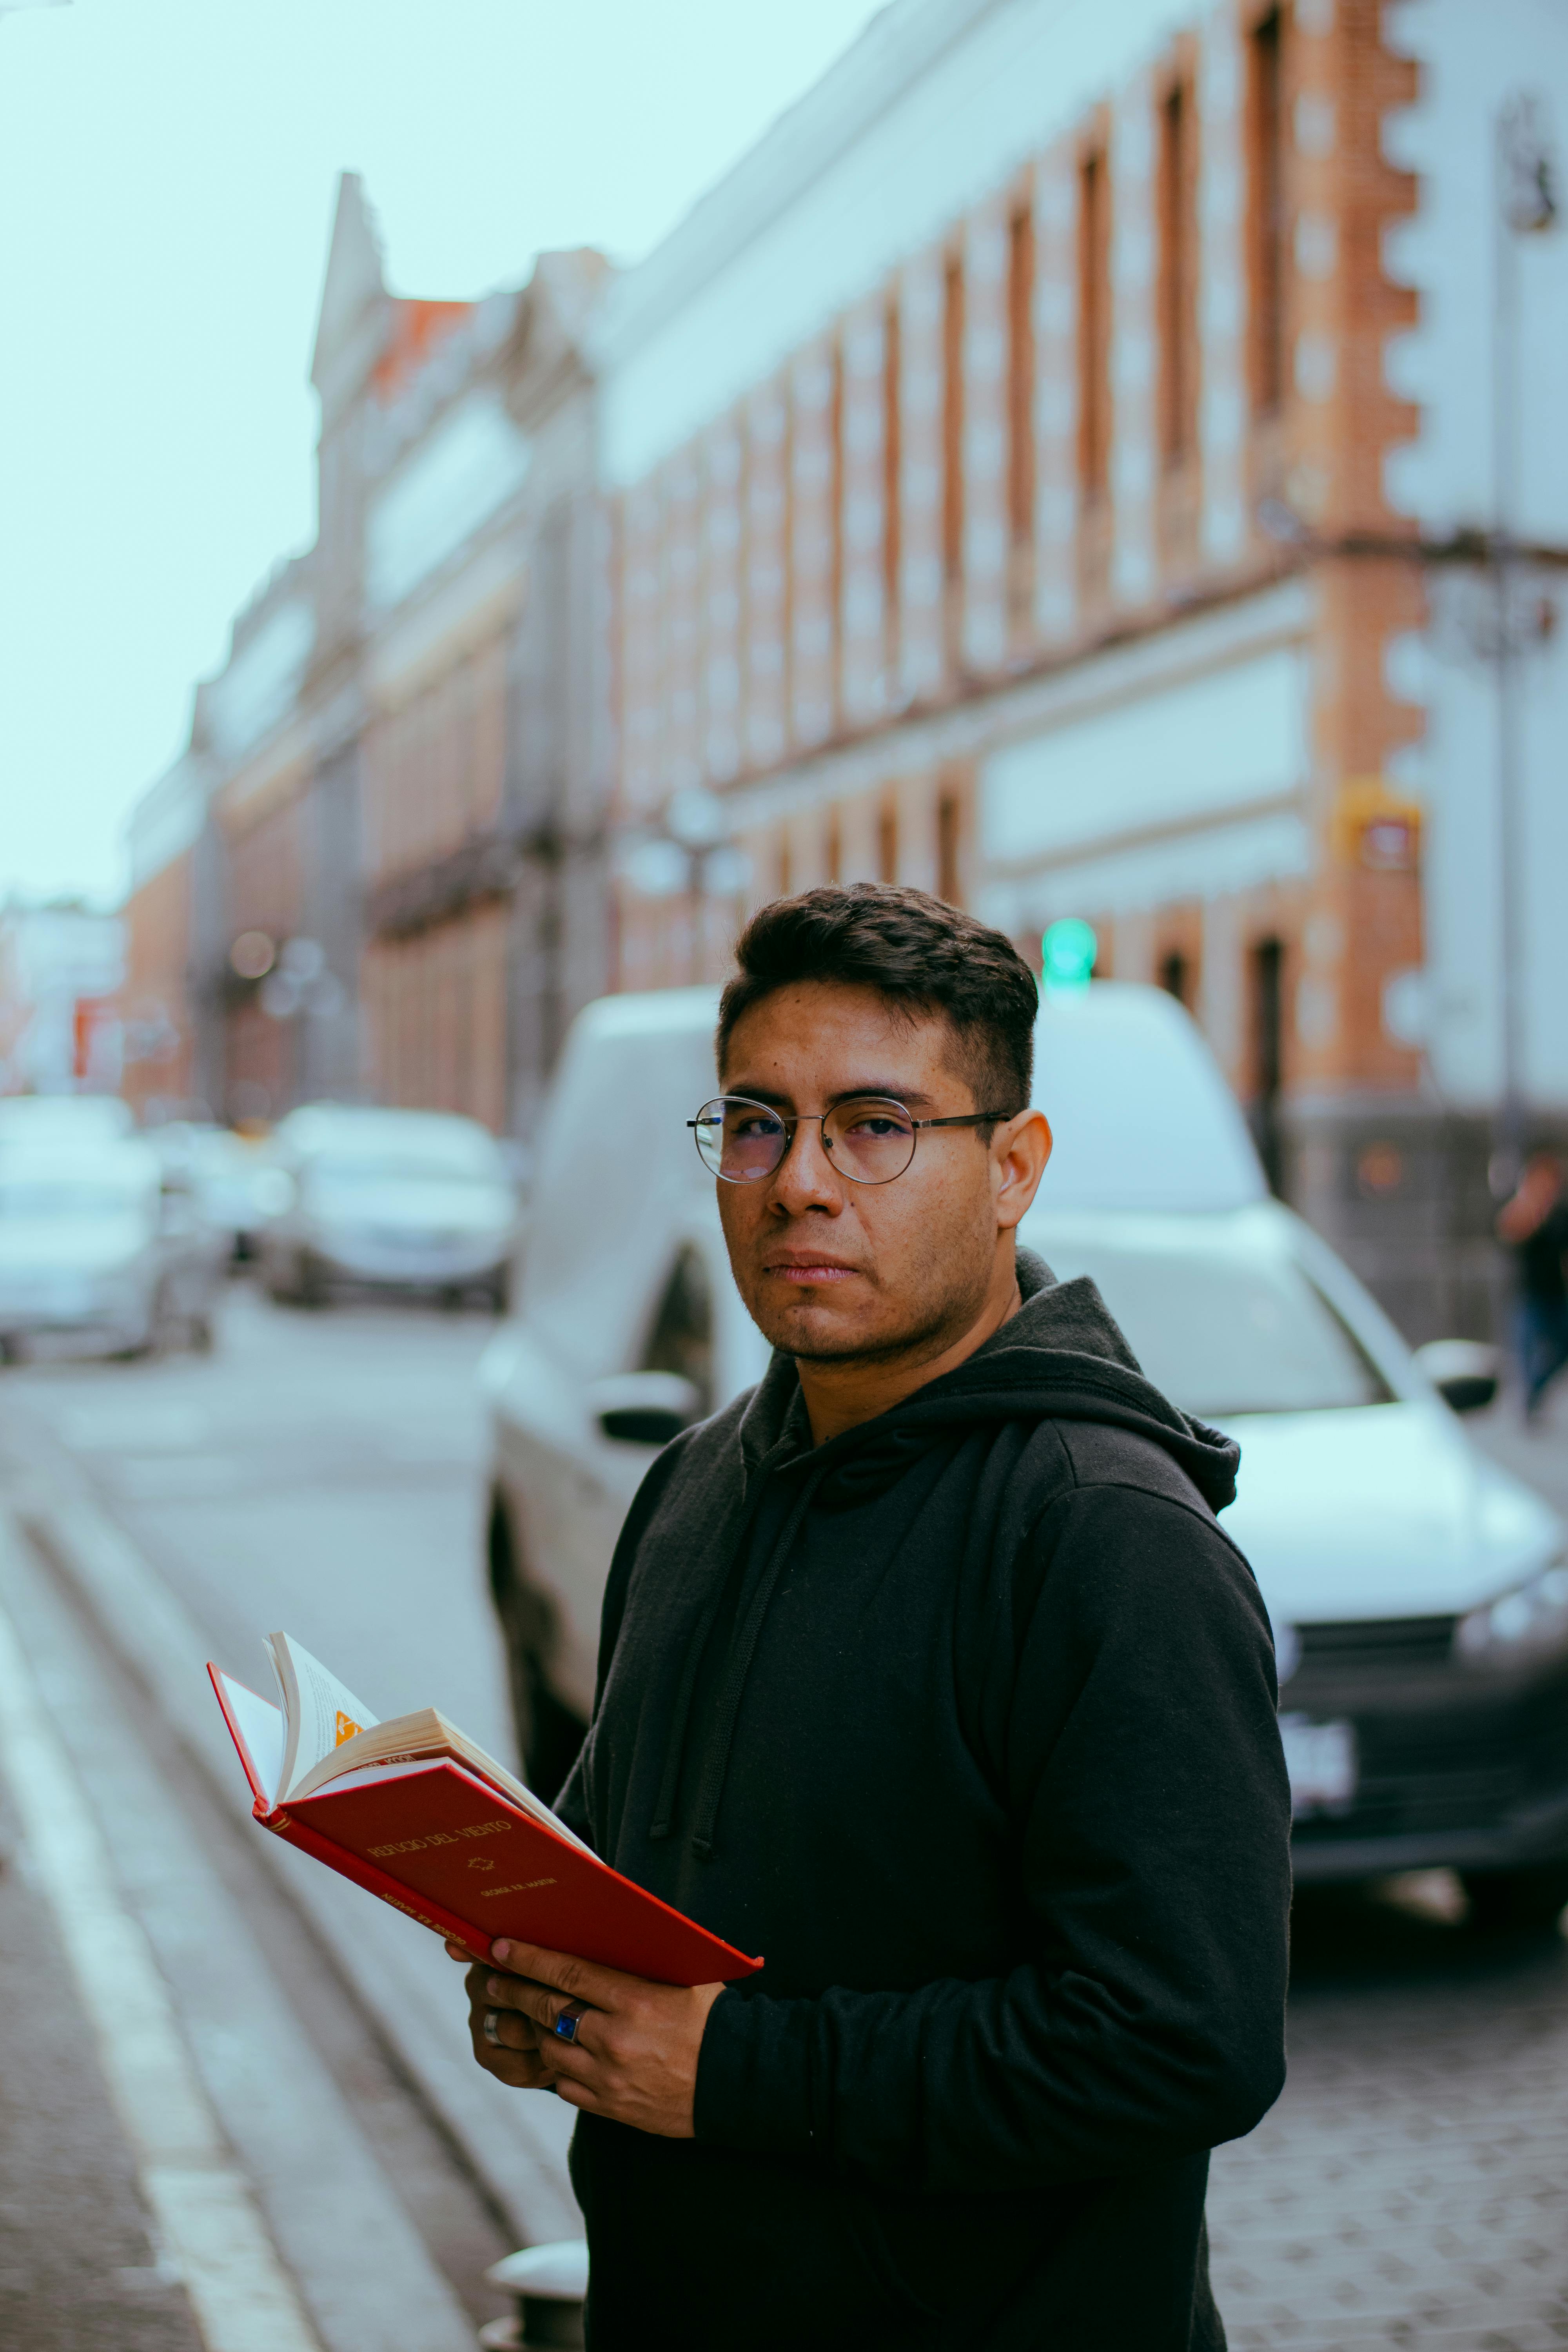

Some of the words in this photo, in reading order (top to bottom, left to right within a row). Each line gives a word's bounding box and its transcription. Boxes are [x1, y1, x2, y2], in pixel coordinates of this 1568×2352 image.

[367, 1839, 428, 1857] REFUGIO
[425, 1833, 459, 1846] DEL
[454, 1820, 512, 1837] VIENTO
[481, 1887, 512, 1896] GEORGE
[525, 1877, 557, 1887] MARTIN
[381, 1893, 417, 1914] MARTIN
[433, 1924, 466, 1945] GEORGE
